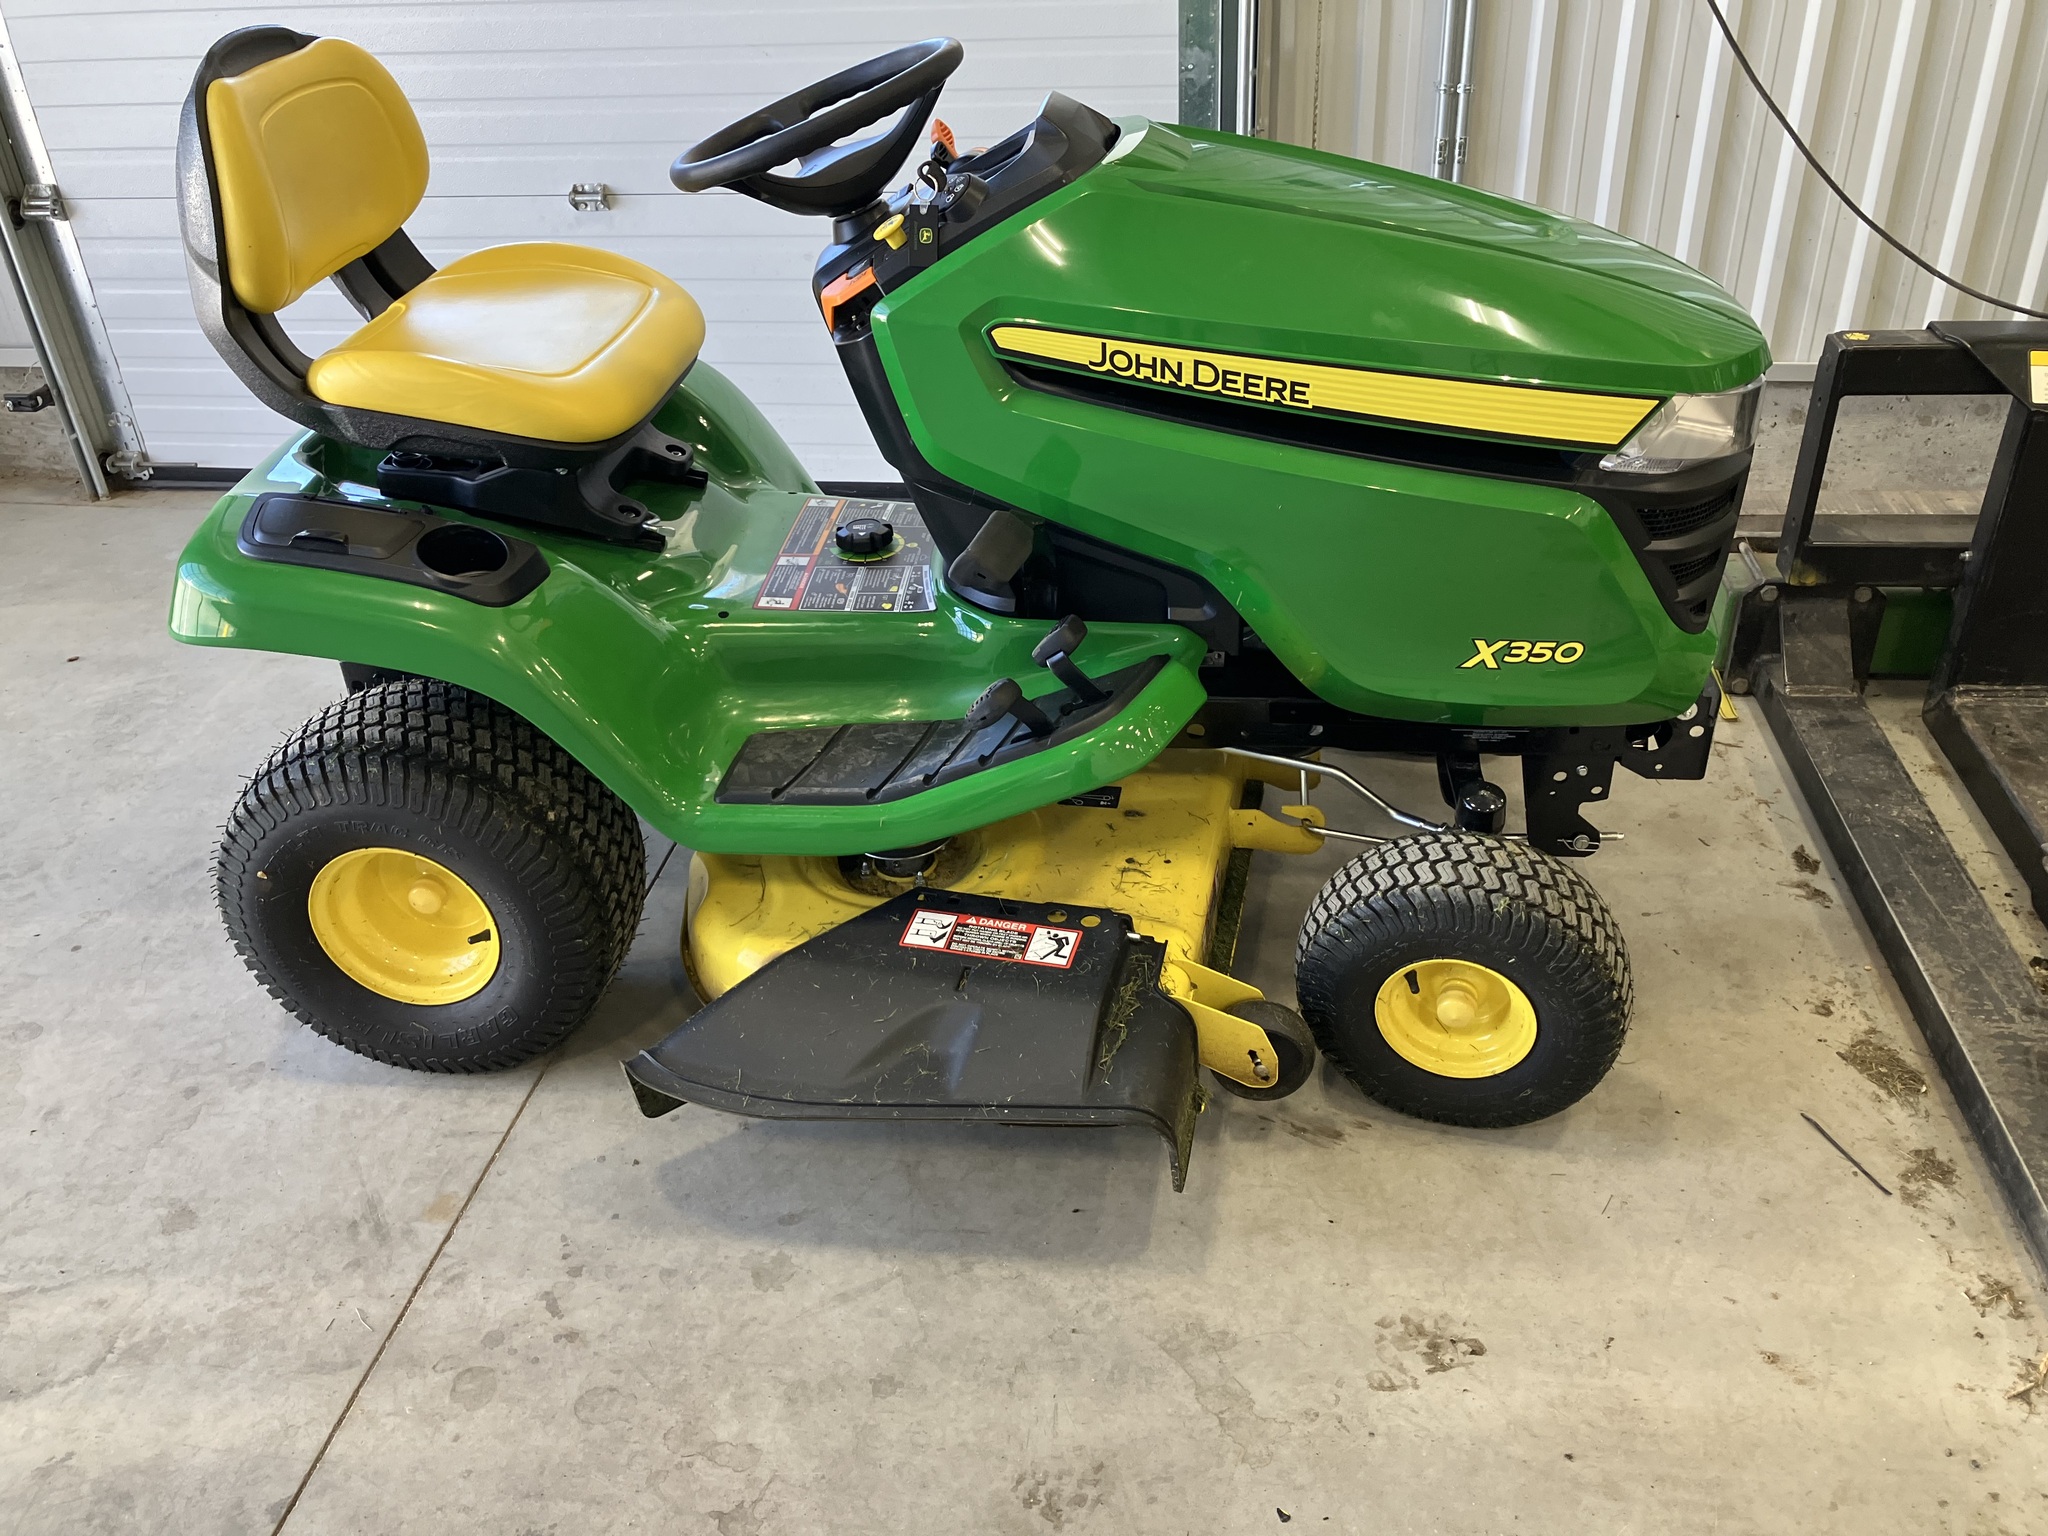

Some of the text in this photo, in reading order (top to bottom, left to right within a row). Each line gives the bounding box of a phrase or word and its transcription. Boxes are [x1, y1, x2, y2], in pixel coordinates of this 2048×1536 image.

[1088, 341, 1312, 406] JOHN DEERE
[1455, 638, 1586, 670] X350
[968, 925, 998, 933] ROTATING
[978, 918, 1027, 931] DANGER
